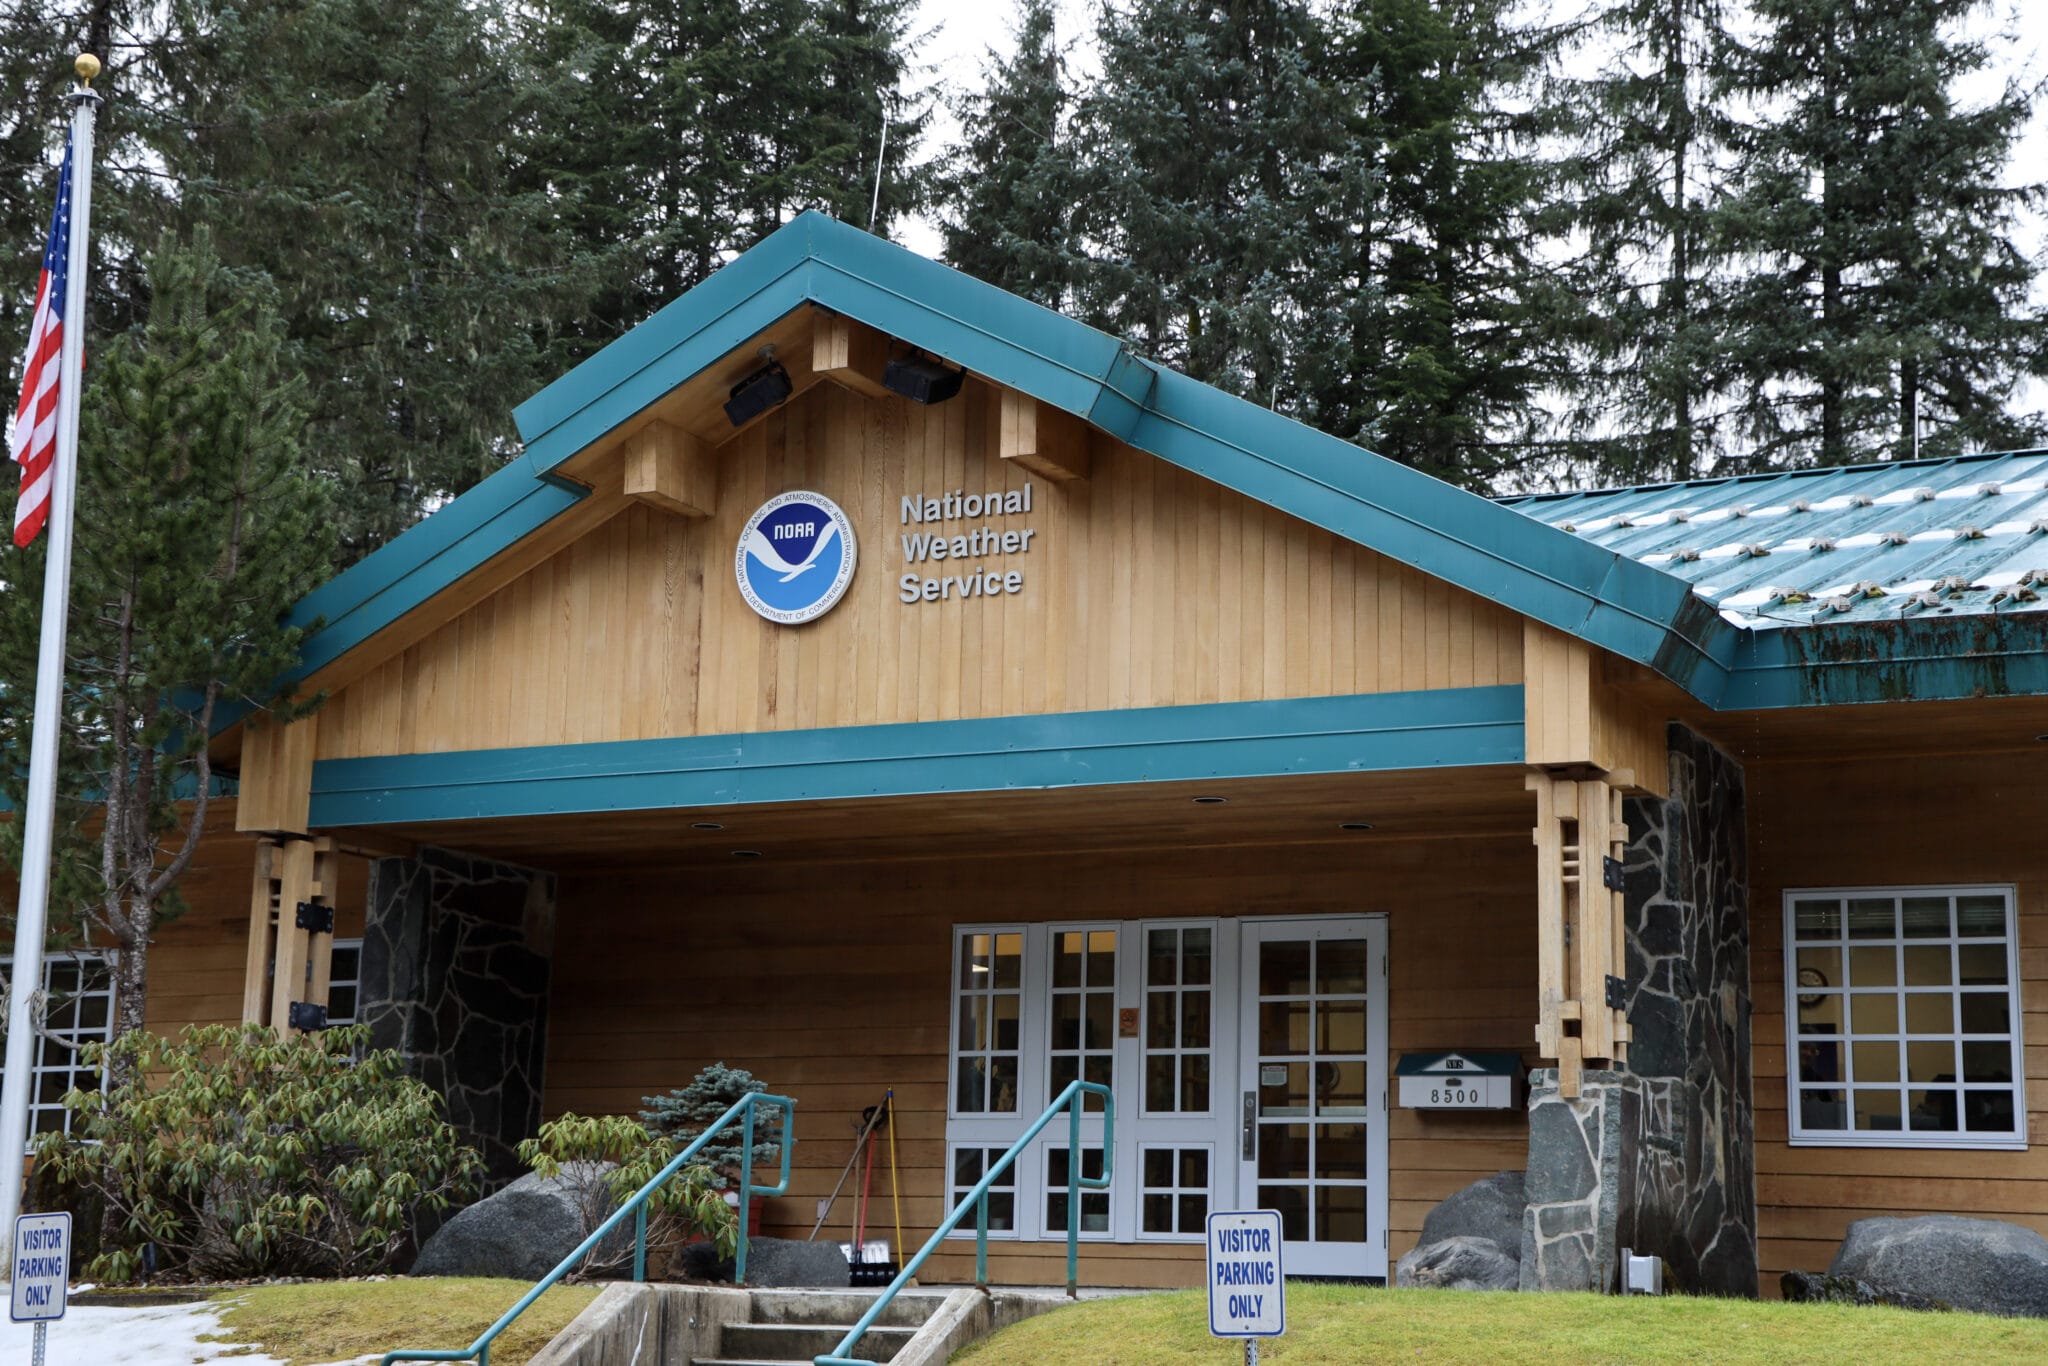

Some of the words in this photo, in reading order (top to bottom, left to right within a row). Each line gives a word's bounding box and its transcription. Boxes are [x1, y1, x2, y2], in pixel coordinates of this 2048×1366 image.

[901, 482, 1032, 524] National
[738, 545, 746, 583] NATIONAL
[742, 509, 766, 541] OCEANIC
[767, 498, 782, 510] AND
[784, 493, 834, 511] ATMOSPHERIC
[832, 511, 852, 575] ADMINISTRATION
[774, 521, 815, 540] NOAA
[901, 526, 1035, 563] Weather
[899, 566, 1023, 604] Service
[749, 596, 793, 620] DEPARTMENT
[795, 610, 806, 620] OF
[808, 577, 844, 615] COMMERCE
[1431, 1089, 1478, 1103] 8500
[23, 1228, 62, 1250] VISITOR
[1218, 1228, 1271, 1253] VISITOR
[18, 1256, 62, 1279] PARKING
[1216, 1261, 1274, 1286] PARKING
[25, 1284, 52, 1306] ONLY
[1228, 1294, 1263, 1319] ONLY
